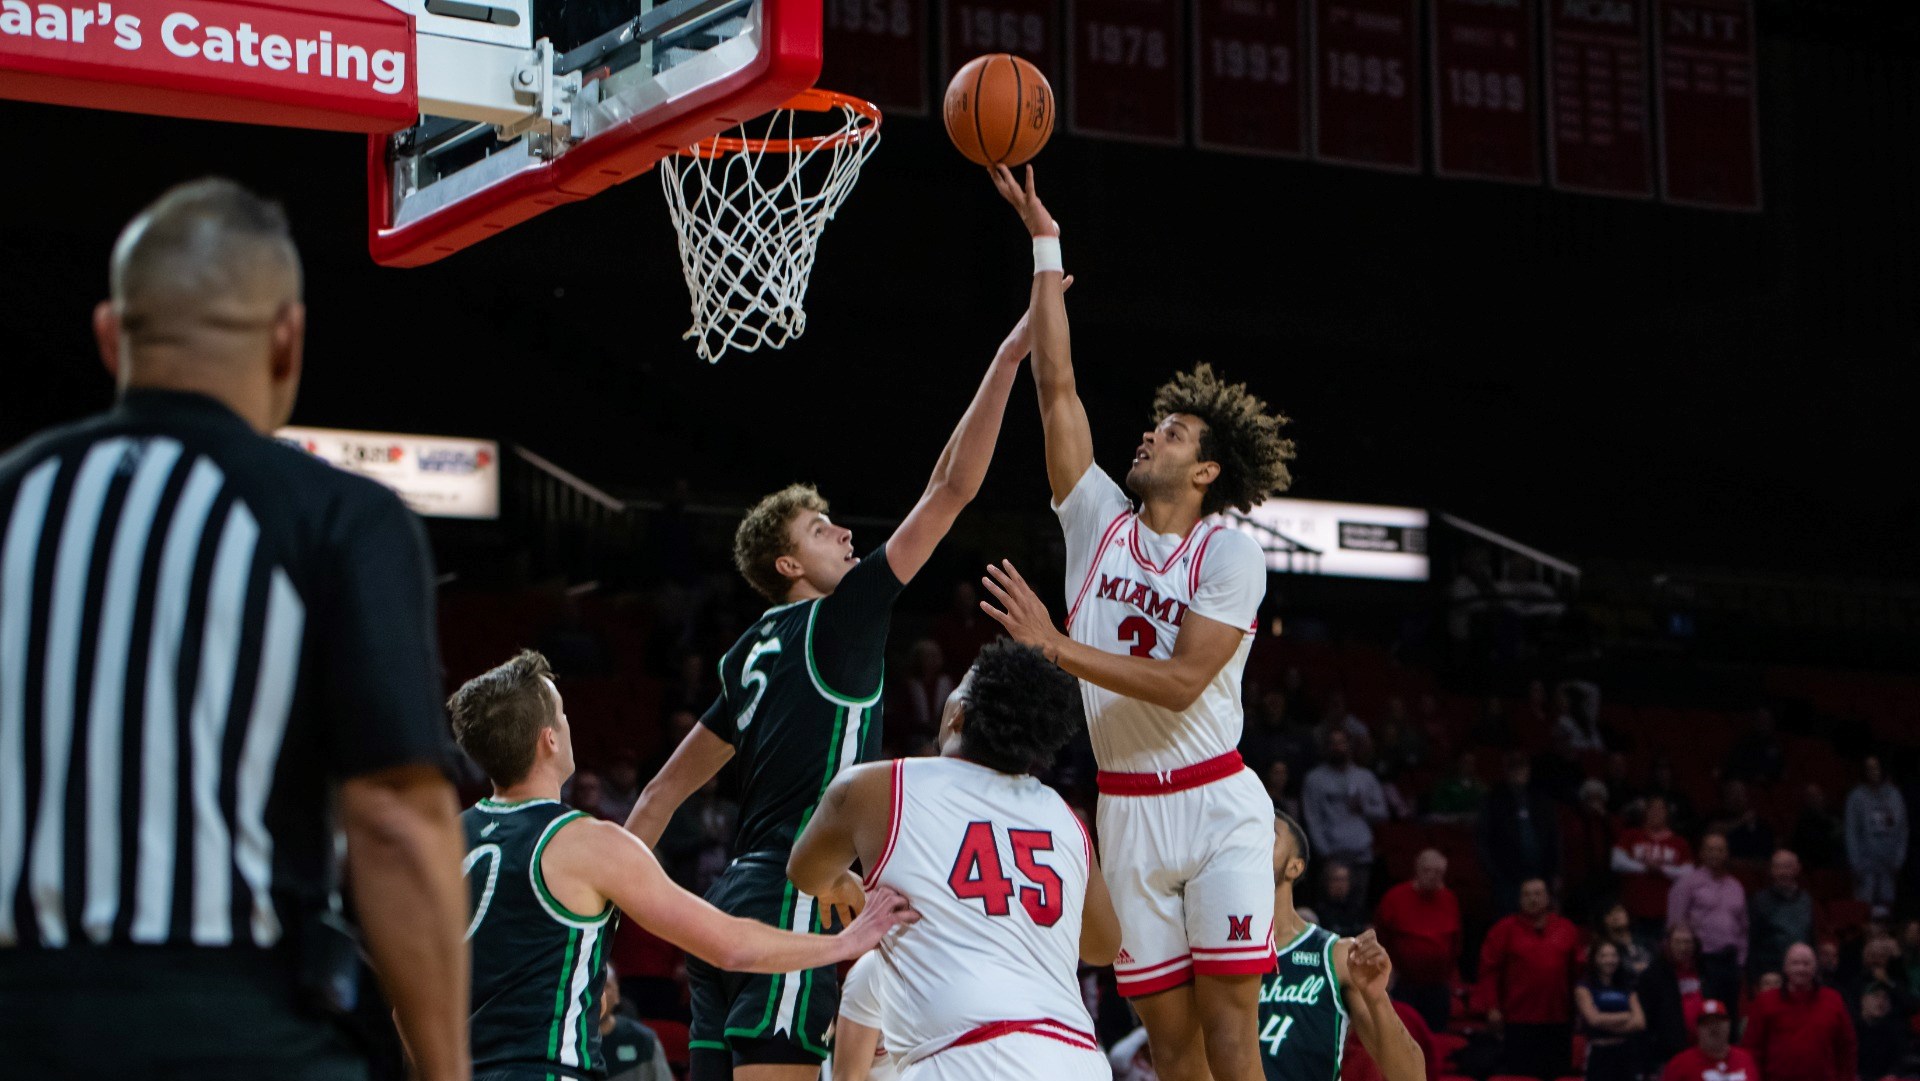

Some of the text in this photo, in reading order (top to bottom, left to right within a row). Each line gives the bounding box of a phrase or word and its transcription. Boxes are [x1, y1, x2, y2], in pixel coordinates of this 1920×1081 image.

[829, 0, 910, 37] 1958
[960, 6, 1042, 52] 1969
[1670, 6, 1741, 42] NIT
[161, 12, 406, 94] Catering
[1087, 21, 1166, 69] 1978
[1096, 573, 1189, 627] MIAMI
[737, 637, 782, 731] 5
[947, 820, 1063, 928] 45
[1227, 915, 1253, 941] M
